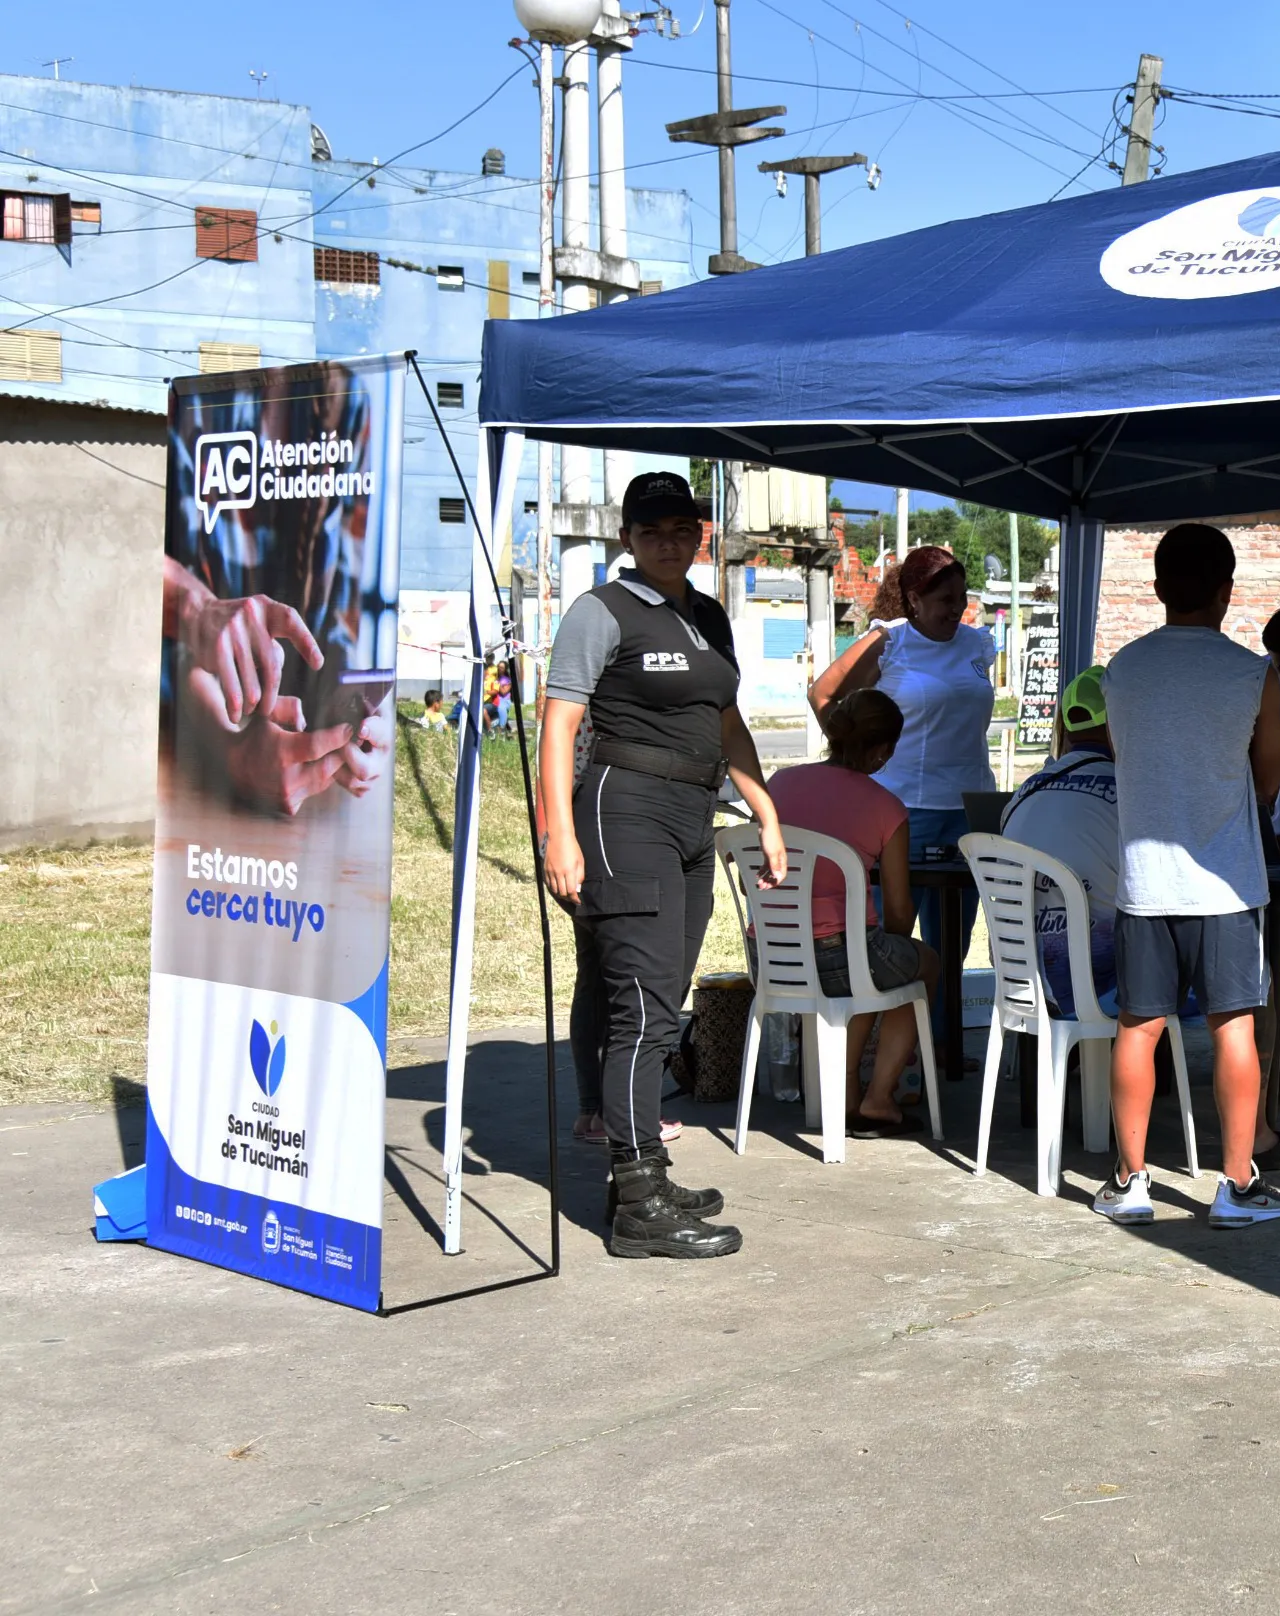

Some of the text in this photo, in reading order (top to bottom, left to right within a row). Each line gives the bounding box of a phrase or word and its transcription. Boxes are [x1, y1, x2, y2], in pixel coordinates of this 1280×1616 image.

[1128, 263, 1170, 276] de
[1155, 249, 1216, 262] San
[260, 430, 353, 468] Atención
[202, 445, 251, 496] AC
[260, 467, 375, 500] Ciudadana
[648, 479, 674, 489] PPC
[643, 652, 688, 665] PPC
[1020, 717, 1053, 728] CHORIZ
[187, 844, 298, 891] Estamos
[186, 888, 325, 942] cerca tuyo
[252, 1101, 280, 1118] CIUDAD
[227, 1113, 306, 1151] San Miguel
[221, 1140, 309, 1179] de Tucumán
